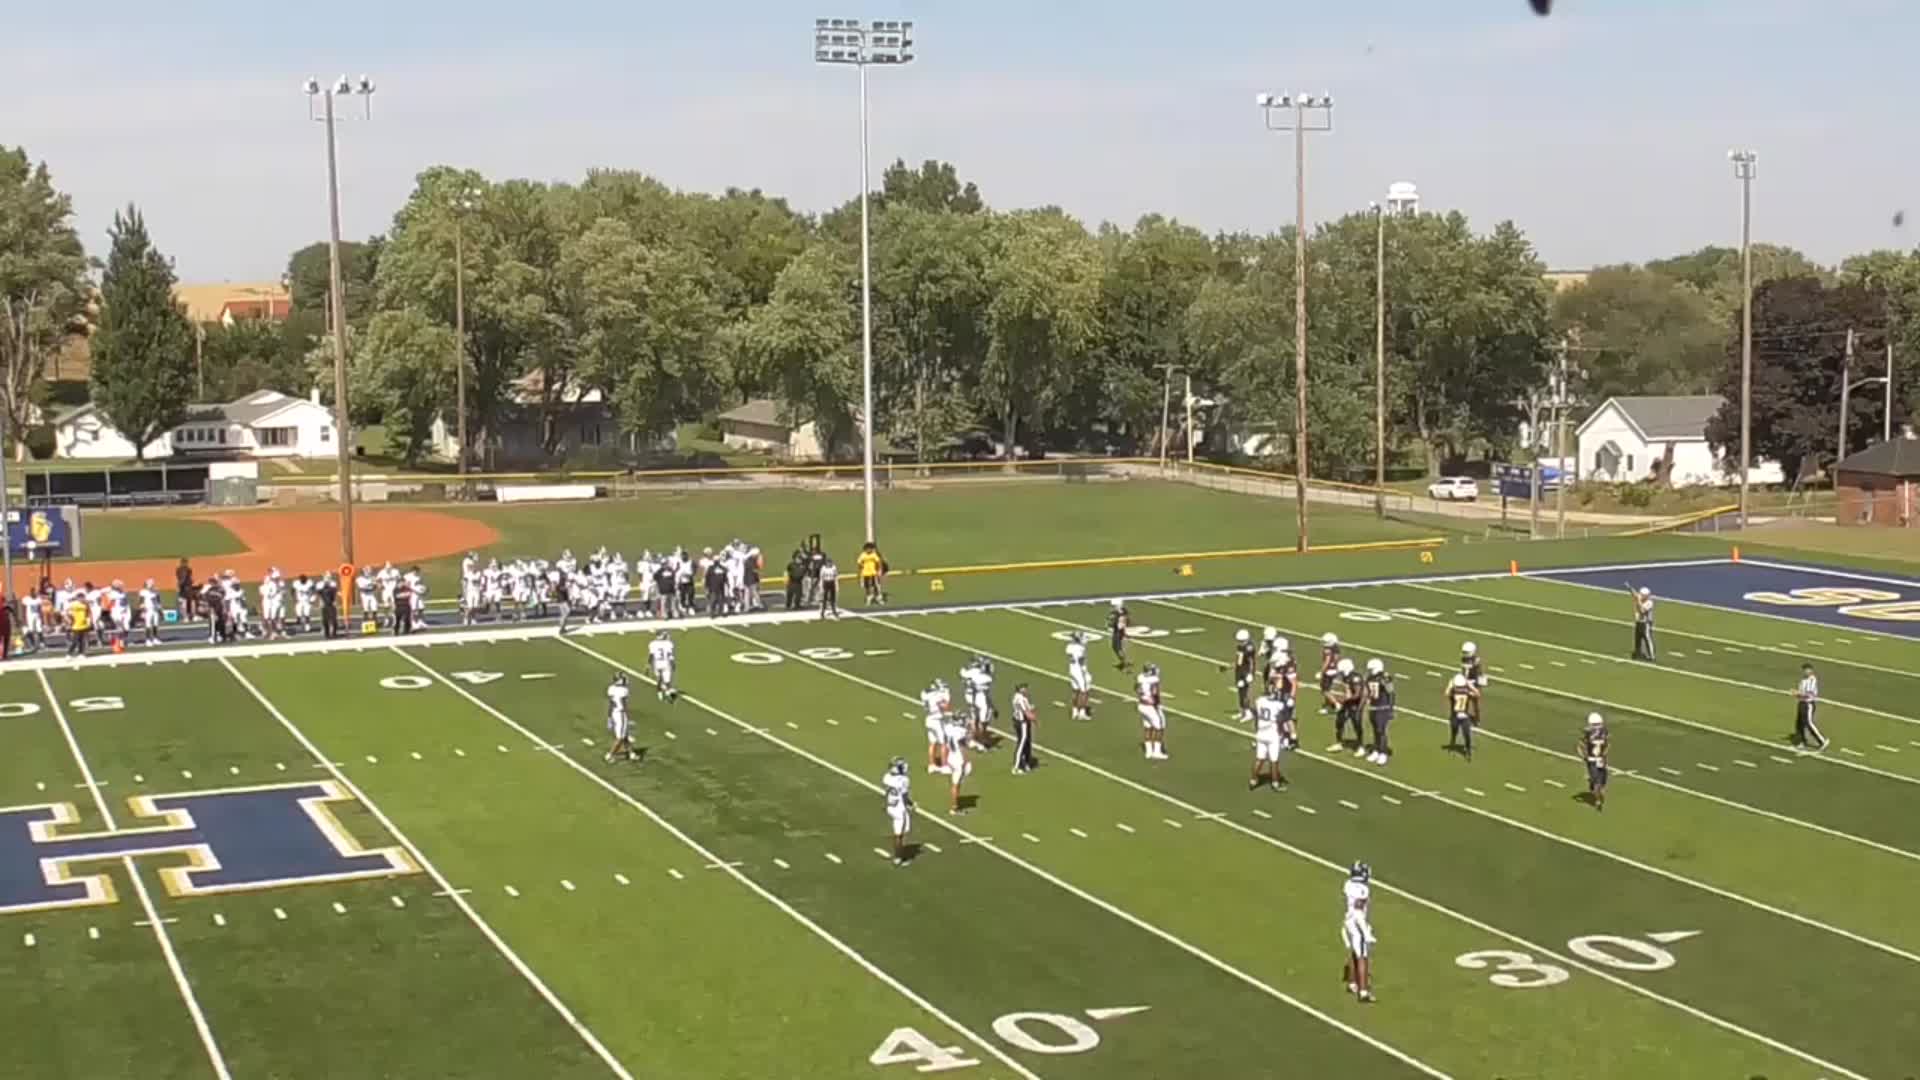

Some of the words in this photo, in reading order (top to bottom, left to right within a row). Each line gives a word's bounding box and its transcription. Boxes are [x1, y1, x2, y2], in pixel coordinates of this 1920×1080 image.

[730, 647, 856, 664] 30
[379, 670, 504, 689] 40
[1455, 935, 1676, 987] 30
[869, 1012, 1100, 1072] 40
